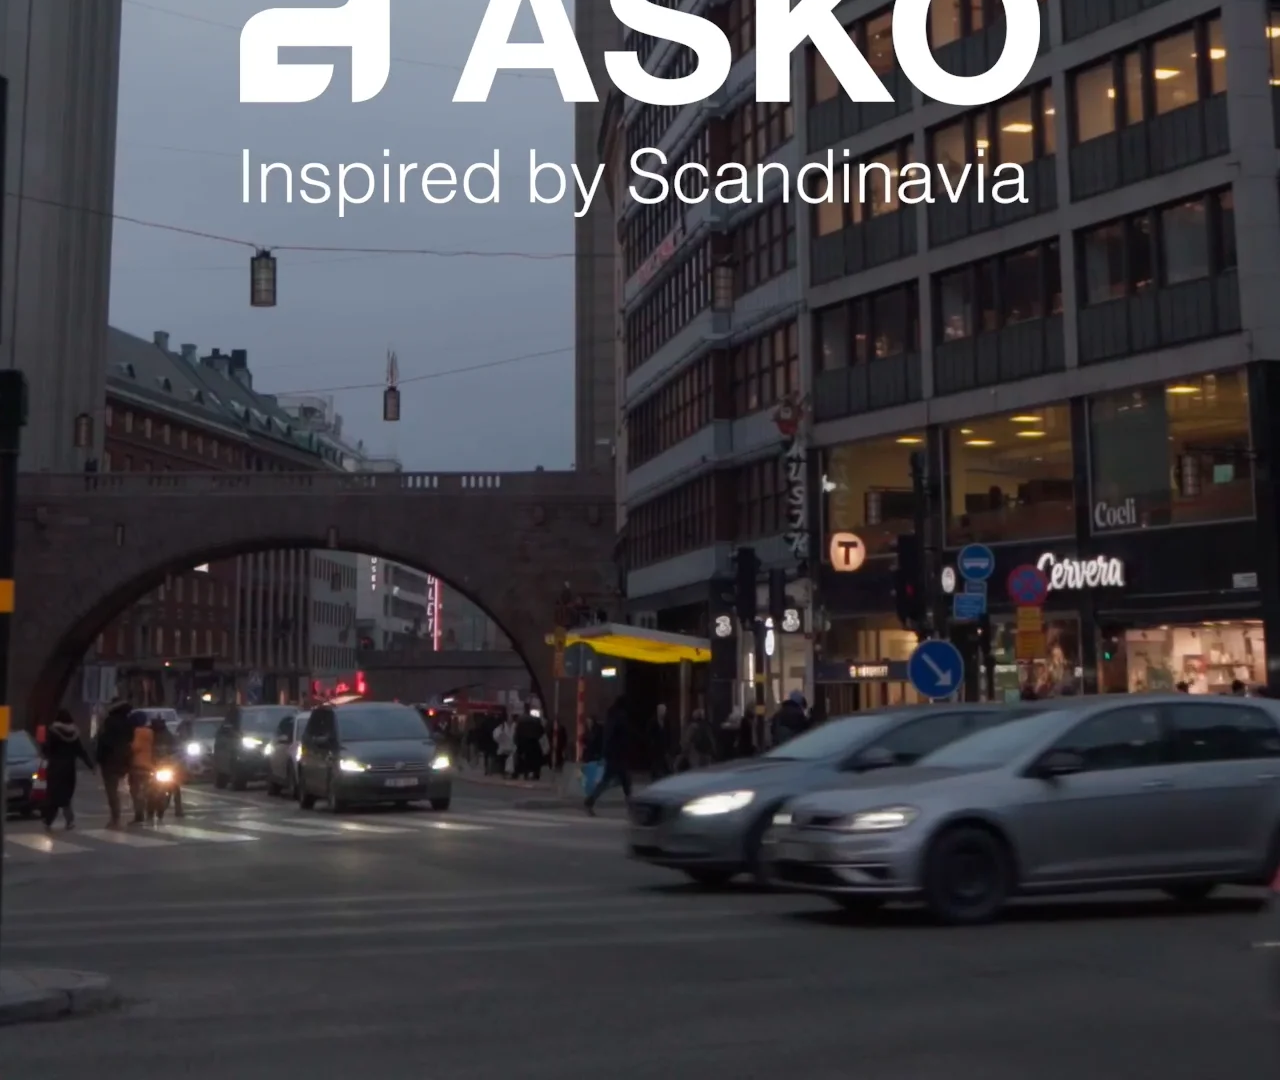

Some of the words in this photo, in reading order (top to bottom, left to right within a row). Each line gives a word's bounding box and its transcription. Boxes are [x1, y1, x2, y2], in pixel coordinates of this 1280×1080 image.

[1095, 498, 1137, 528] Coeli
[838, 541, 858, 565] T
[1037, 552, 1125, 592] Cervera
[716, 615, 732, 638] 3
[783, 609, 800, 633] 3
